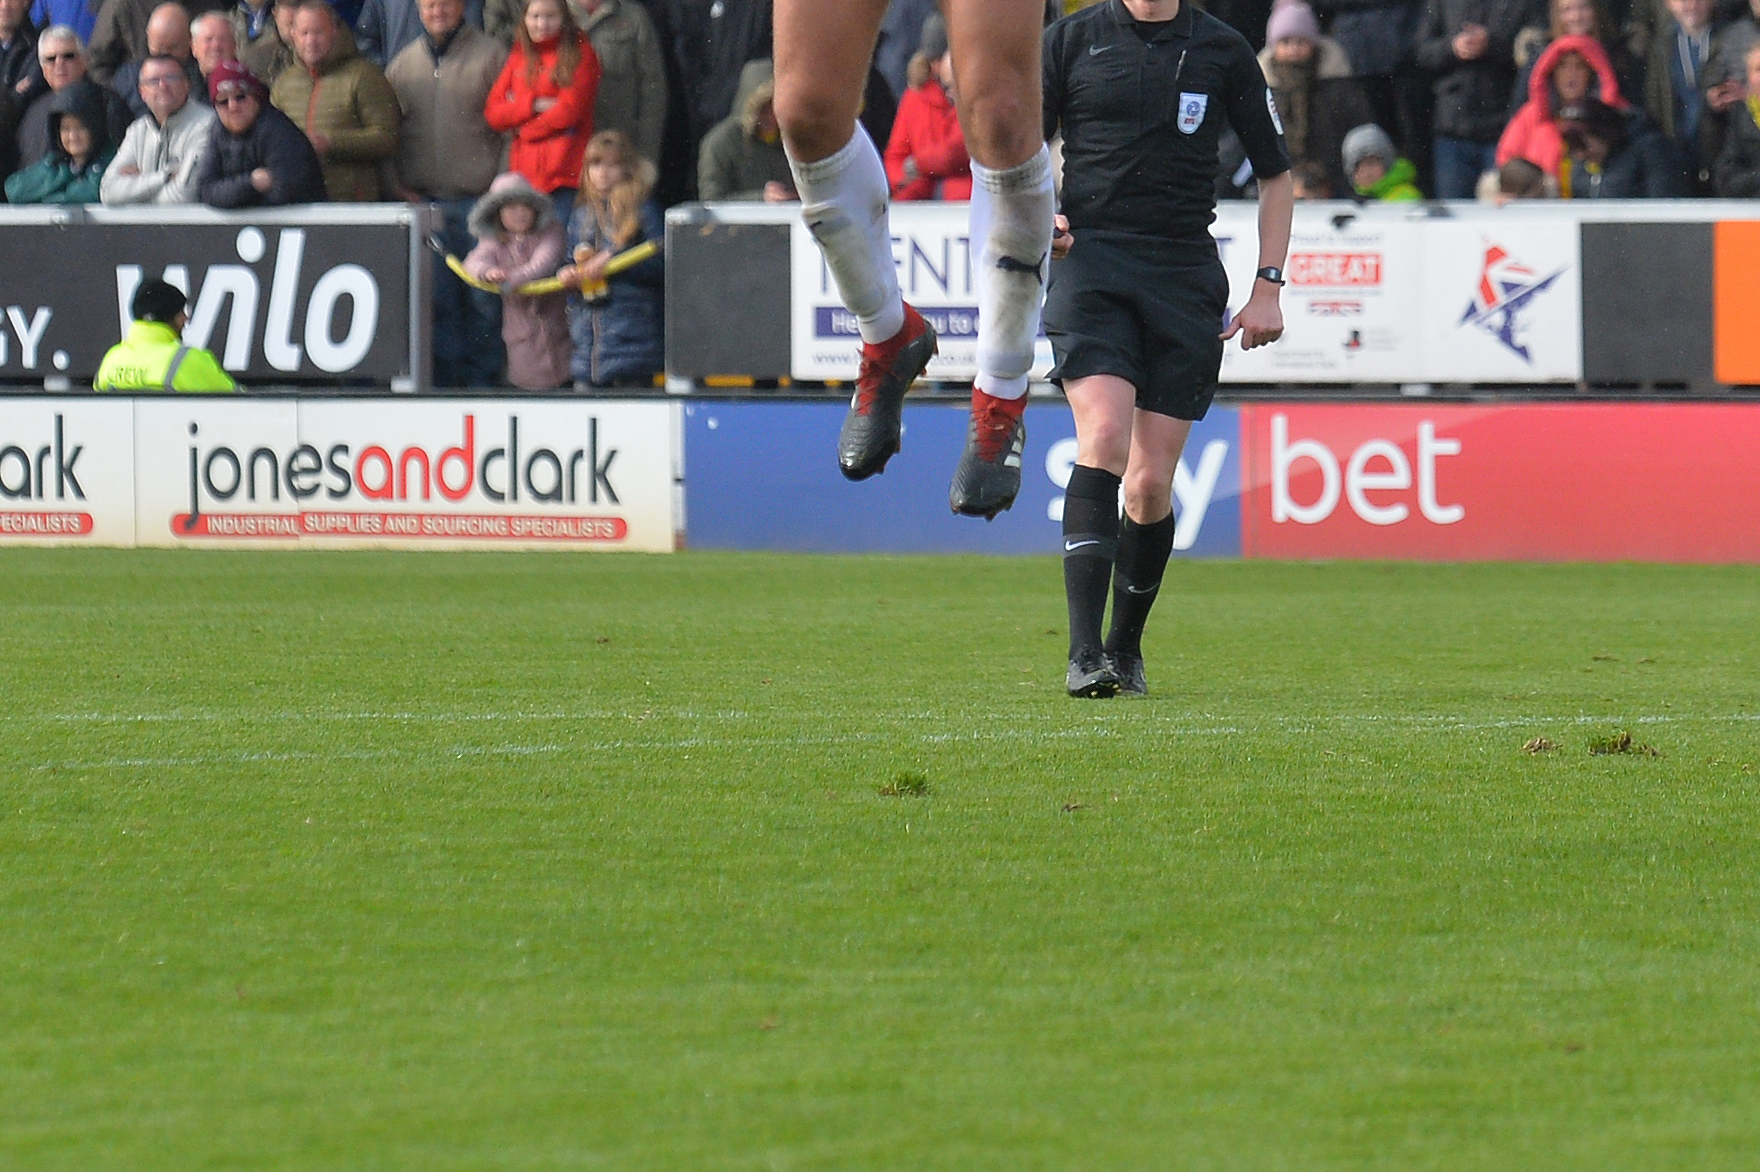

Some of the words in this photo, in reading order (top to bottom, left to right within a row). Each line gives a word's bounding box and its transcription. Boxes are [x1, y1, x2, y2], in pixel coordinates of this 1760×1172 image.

[116, 226, 379, 373] wilo
[1291, 255, 1379, 284] GREAT
[1270, 413, 1465, 526] bet
[206, 514, 299, 537] INDUSTRIAL
[303, 512, 383, 534] SUPPLIES
[385, 514, 418, 534] AND
[421, 515, 507, 537] SOURCING
[510, 517, 616, 540] SPECIALISTS
